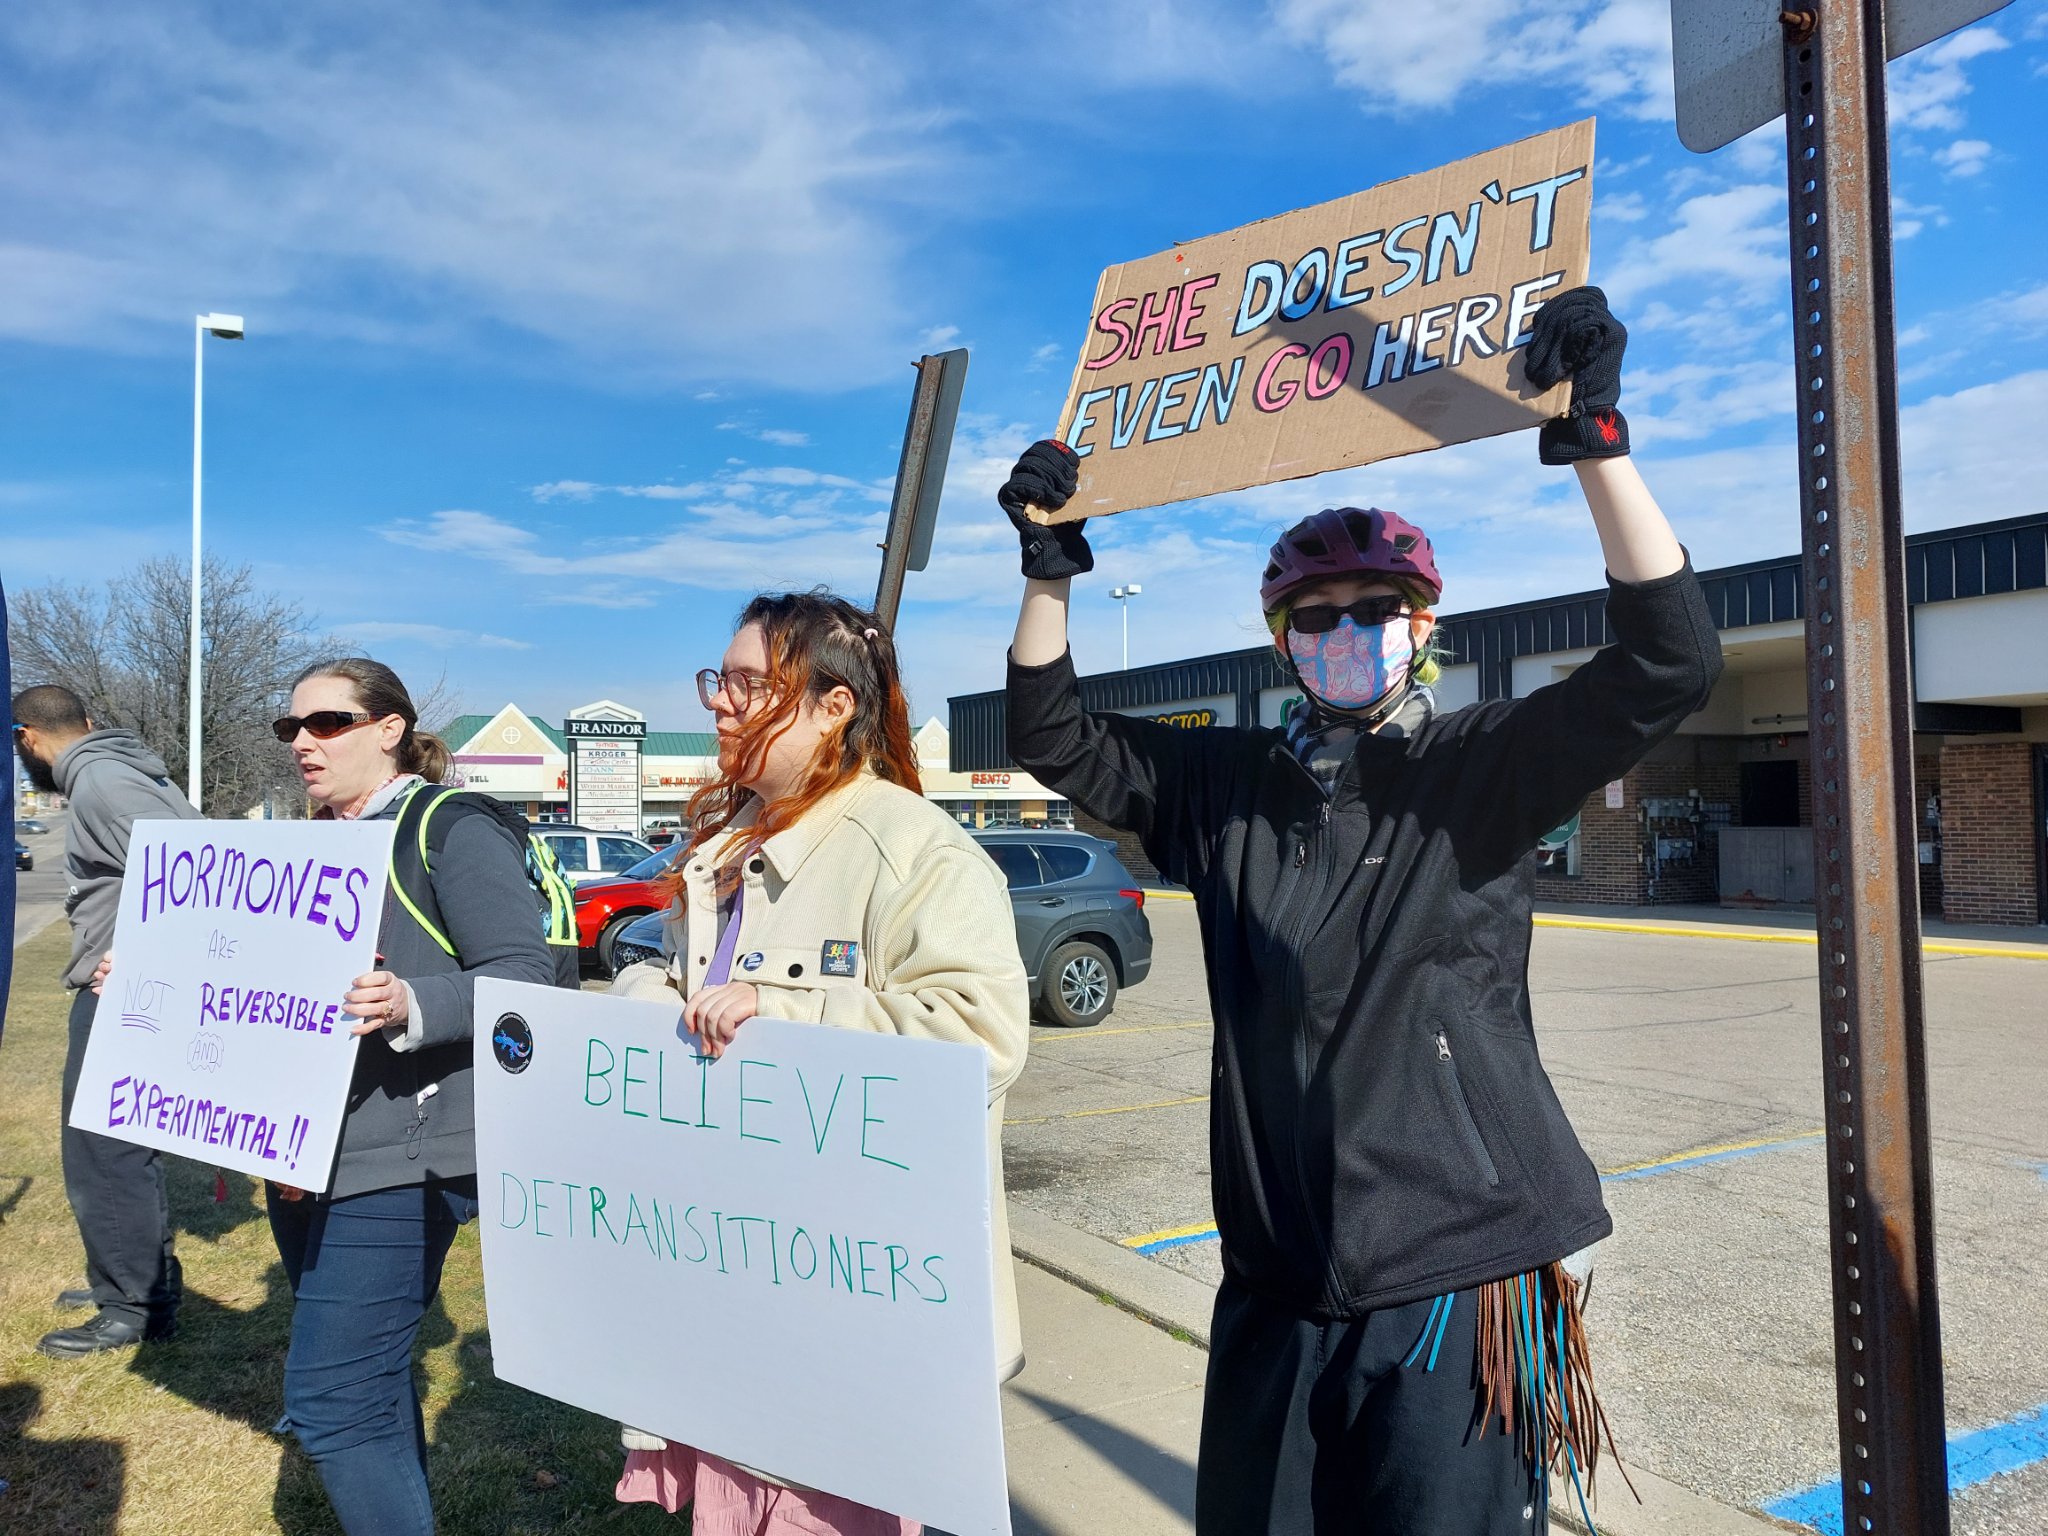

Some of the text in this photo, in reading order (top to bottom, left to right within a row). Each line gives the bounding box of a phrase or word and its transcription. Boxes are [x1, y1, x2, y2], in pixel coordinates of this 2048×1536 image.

[1065, 269, 1568, 459] EVEN GO HERE
[1085, 273, 1222, 371] SHE
[571, 722, 644, 736] FRANDOR
[971, 773, 1010, 784] BENTO
[142, 842, 369, 942] HORMONES
[207, 929, 240, 959] ARE
[122, 973, 339, 1035] NOT REVERSIBLE
[191, 1042, 219, 1064] AND
[108, 1075, 310, 1170] EXPERIMENTAL!!
[584, 1038, 911, 1170] BELIEVE
[499, 1172, 948, 1303] DETRANSITIONERS
